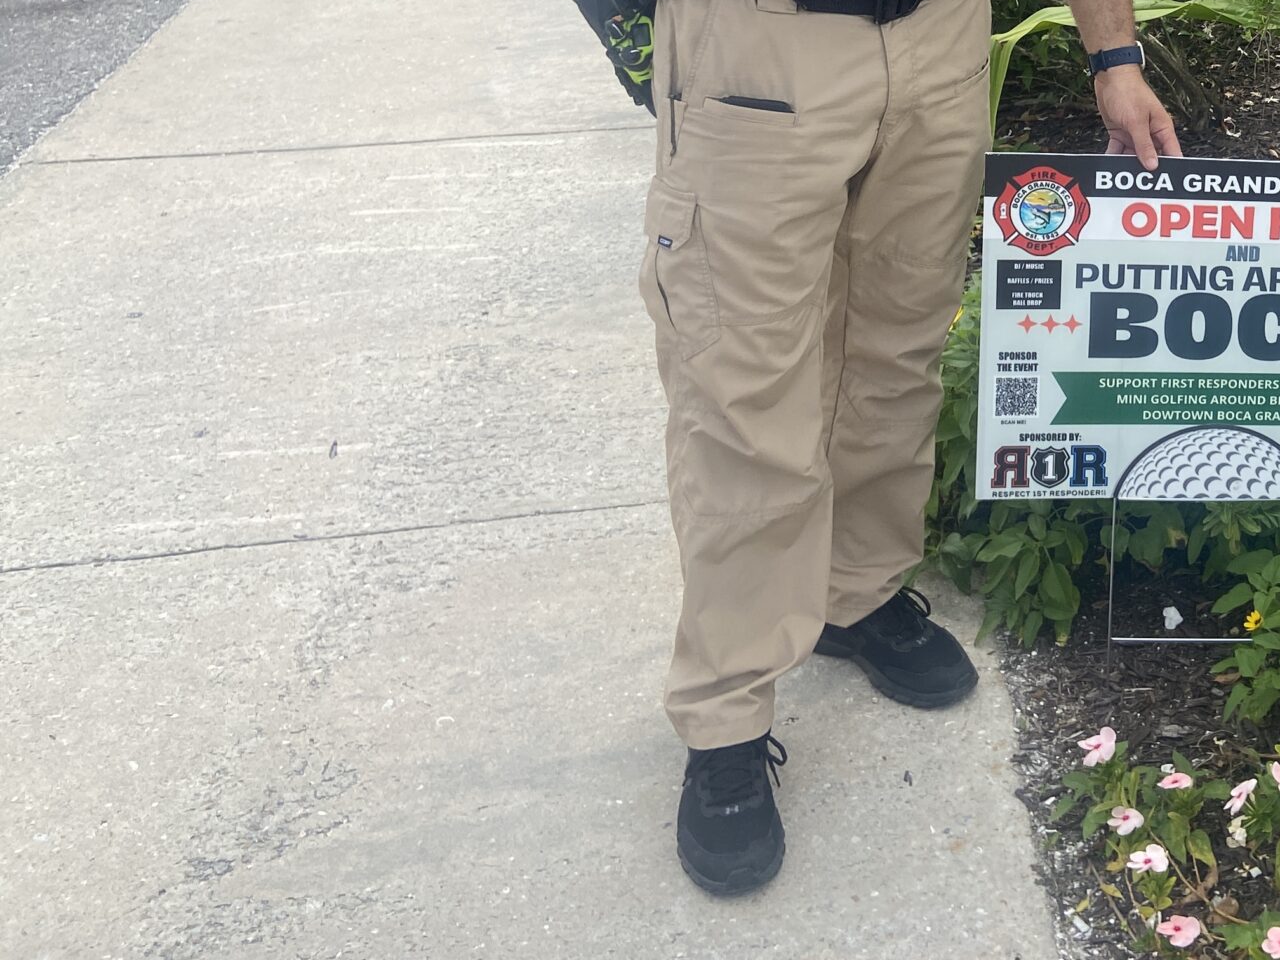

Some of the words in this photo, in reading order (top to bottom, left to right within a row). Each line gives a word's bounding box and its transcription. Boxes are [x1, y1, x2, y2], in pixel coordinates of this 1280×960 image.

[1031, 171, 1057, 180] FIRE
[1095, 171, 1174, 191] BOCA
[1012, 189, 1028, 209] BOCA
[1027, 182, 1062, 192] GRANDE
[1122, 202, 1255, 239] OPEN
[1225, 245, 1260, 262] AND
[1075, 263, 1234, 291] PUTTING
[998, 352, 1037, 360] SPONSOR
[997, 363, 1012, 372] THE
[1014, 363, 1038, 372] EVENT
[1099, 378, 1158, 388] SUPPORT
[1161, 379, 1195, 389] FIRST
[1198, 379, 1280, 390] RESPONDERS
[1116, 394, 1147, 404] MINI
[1150, 395, 1207, 404] GOLFING
[1210, 395, 1266, 405] AROUND
[1142, 410, 1213, 420] DOWTOWN
[1217, 411, 1252, 420] BOCA
[1019, 433, 1067, 441] SPONSORED
[1069, 433, 1082, 441] BY:
